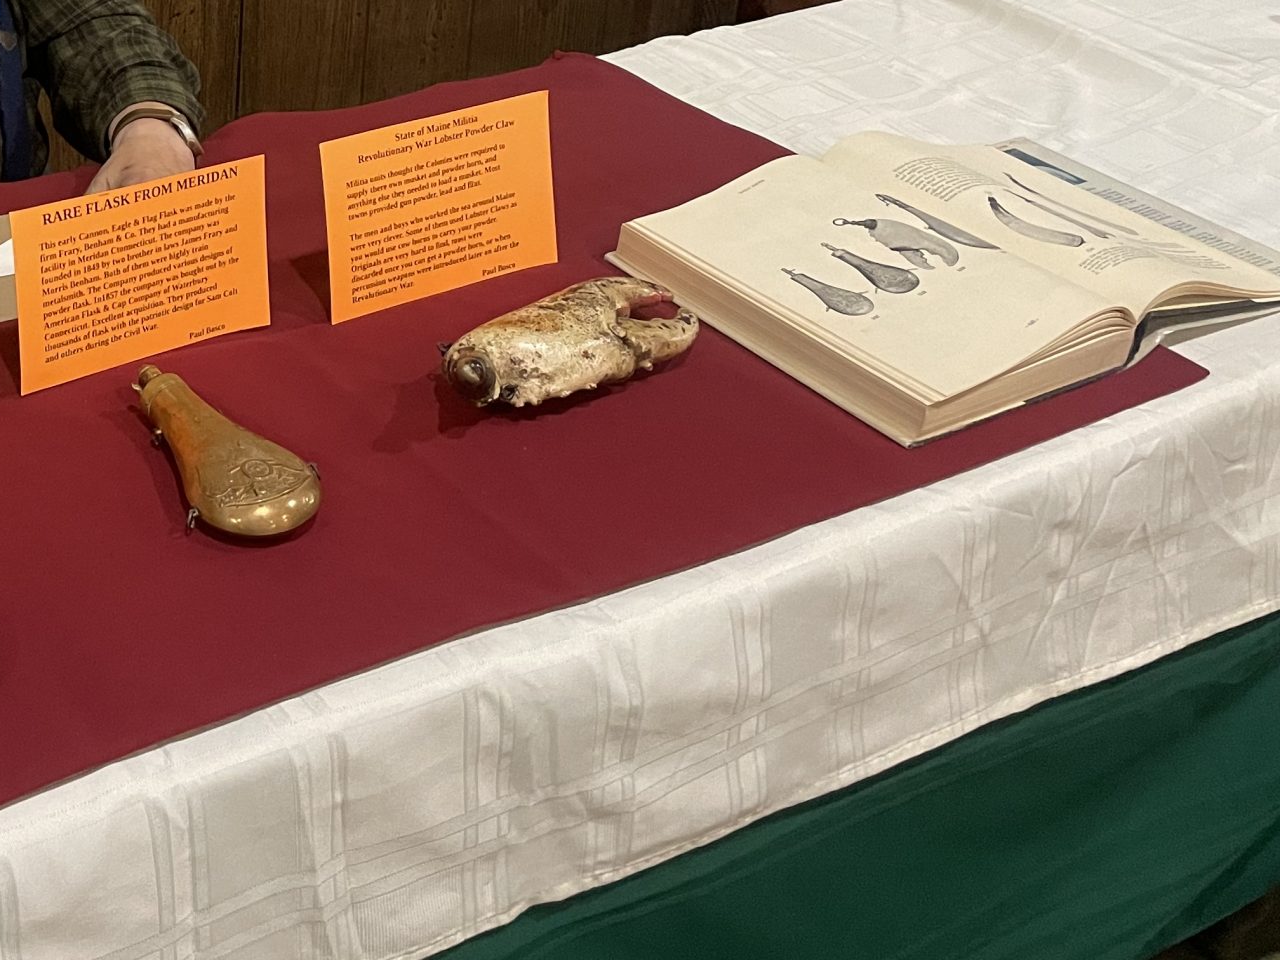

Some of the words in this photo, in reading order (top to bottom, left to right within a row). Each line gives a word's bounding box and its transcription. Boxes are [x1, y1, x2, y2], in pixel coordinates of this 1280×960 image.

[357, 145, 413, 164] Revolutionary
[414, 139, 432, 149] War
[434, 131, 463, 145] Lobster
[465, 124, 494, 137] Powder
[495, 119, 514, 129] Claw
[394, 131, 415, 141] State
[416, 126, 425, 136] of
[426, 122, 451, 134] Maine
[452, 116, 478, 127] Militia
[42, 205, 82, 225] RARE
[85, 193, 130, 215] FLASK
[134, 182, 172, 203] FROM
[176, 166, 237, 191] MERIDAN
